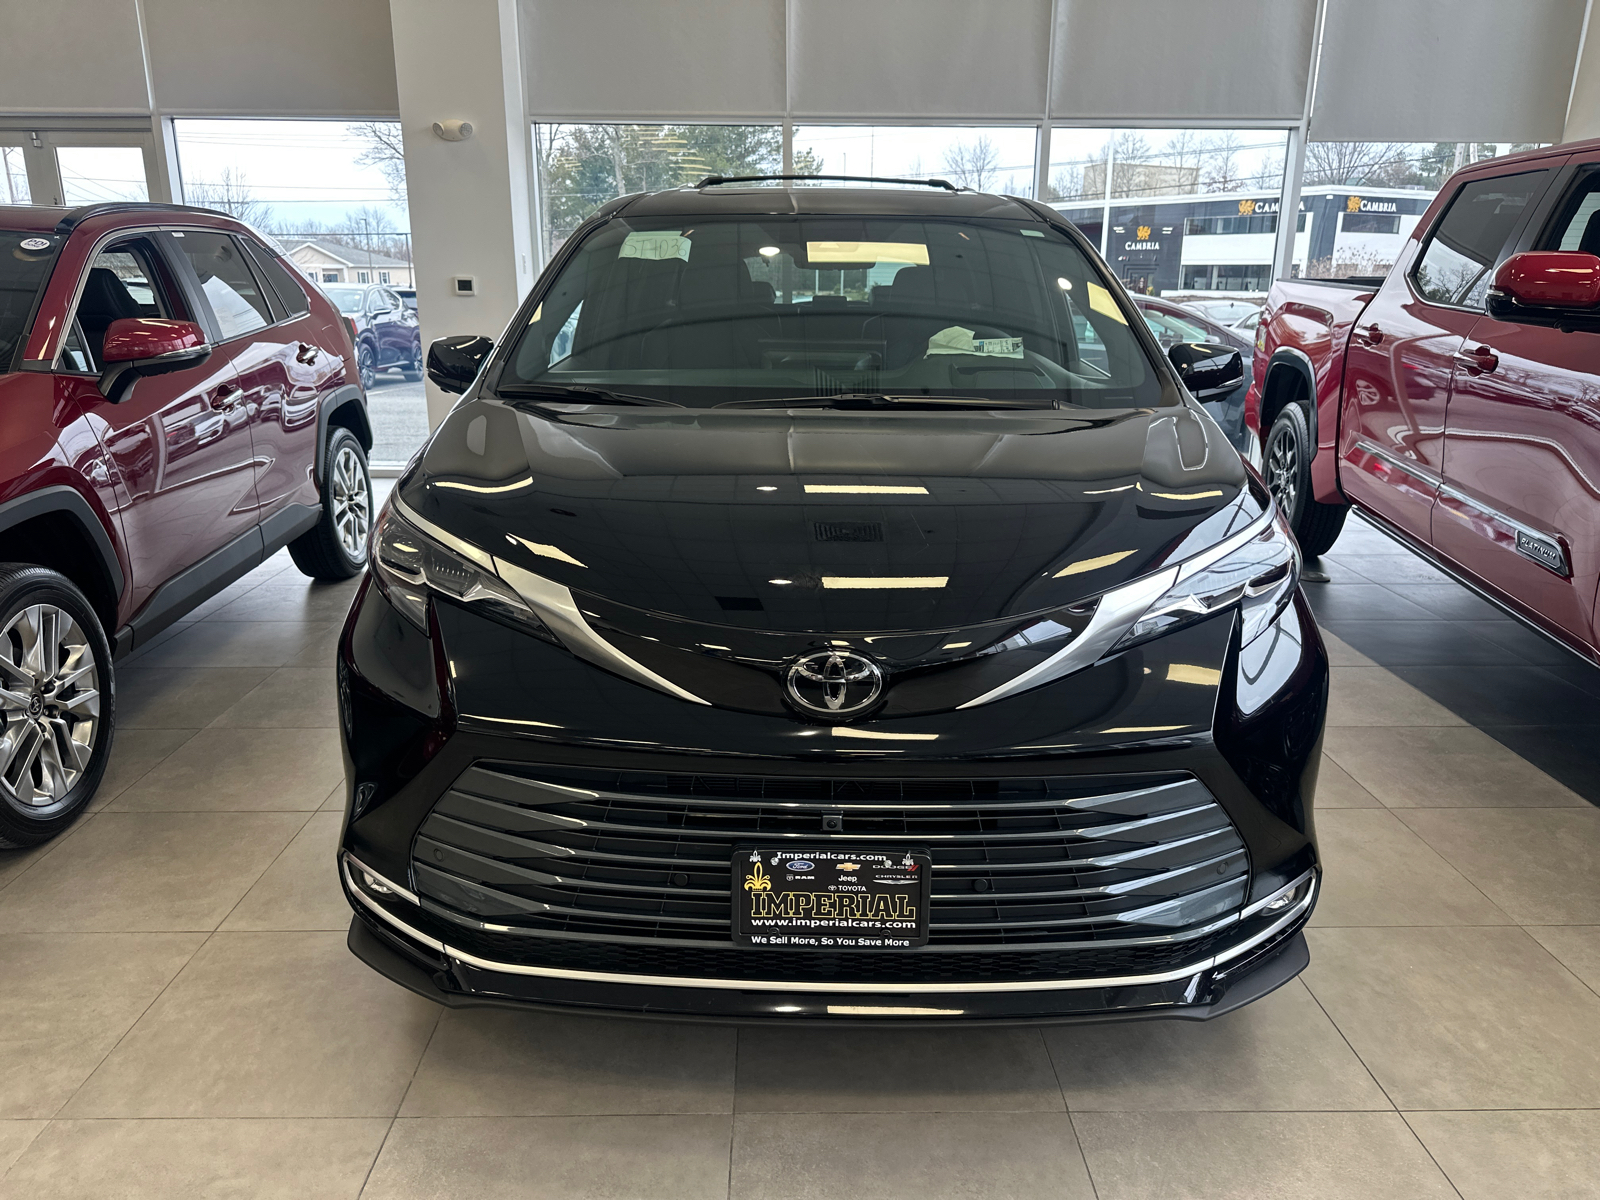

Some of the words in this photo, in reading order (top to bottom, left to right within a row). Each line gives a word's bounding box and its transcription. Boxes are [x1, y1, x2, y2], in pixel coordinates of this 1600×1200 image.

[1254, 201, 1305, 213] CAMA
[1360, 200, 1397, 212] CAMBRIA
[1125, 241, 1160, 250] CAMBRIA
[1521, 537, 1556, 560] PLATINUM
[776, 852, 887, 861] Imperialcars.com
[838, 874, 858, 883] Jeep
[751, 891, 916, 920] IMPERIAL
[751, 918, 916, 928] www.imperialcars.com
[751, 936, 768, 944] We
[769, 936, 788, 944] Sell
[790, 937, 819, 946] More,
[820, 937, 834, 945] So
[857, 938, 882, 946] Save
[884, 939, 910, 947] More
